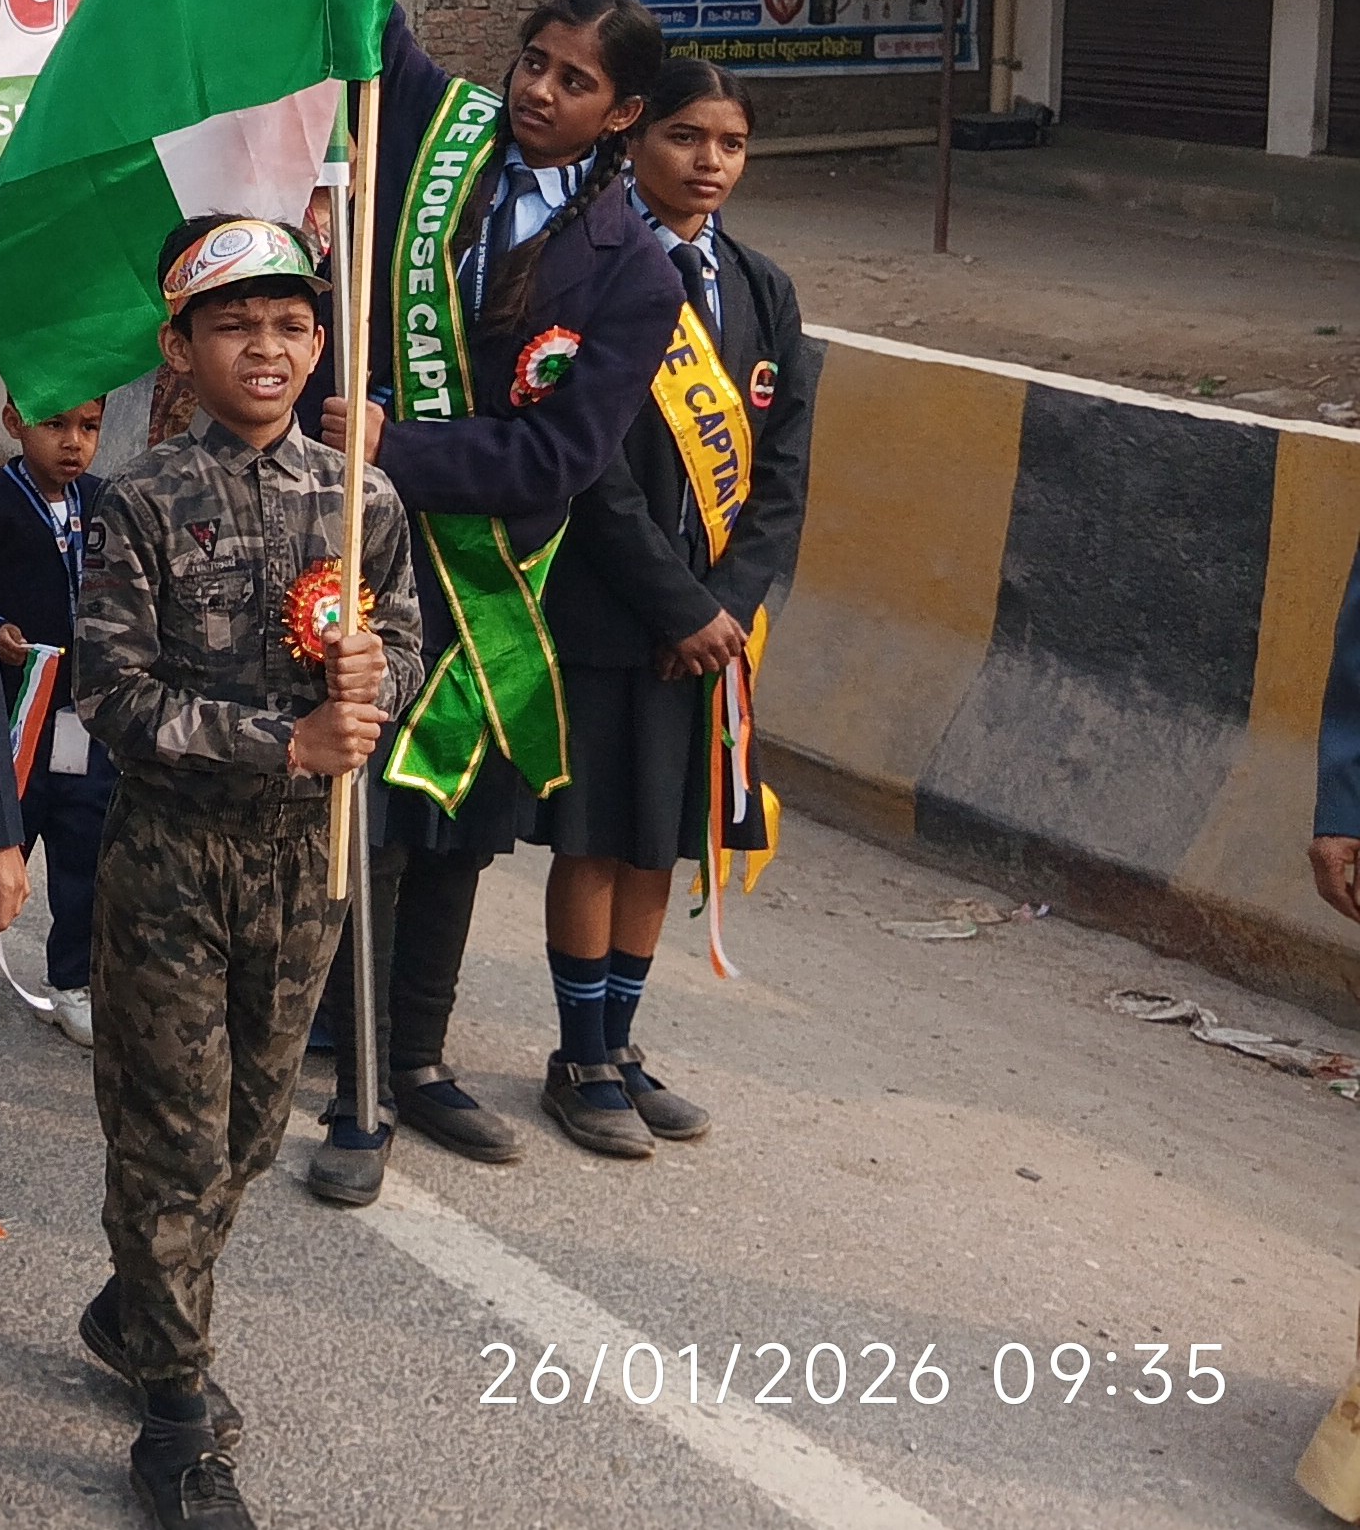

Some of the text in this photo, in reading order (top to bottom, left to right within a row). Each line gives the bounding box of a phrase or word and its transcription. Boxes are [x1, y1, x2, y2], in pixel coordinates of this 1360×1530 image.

[407, 86, 504, 425] ICE HOUSE CAPT
[684, 382, 744, 534] CAPTAIN
